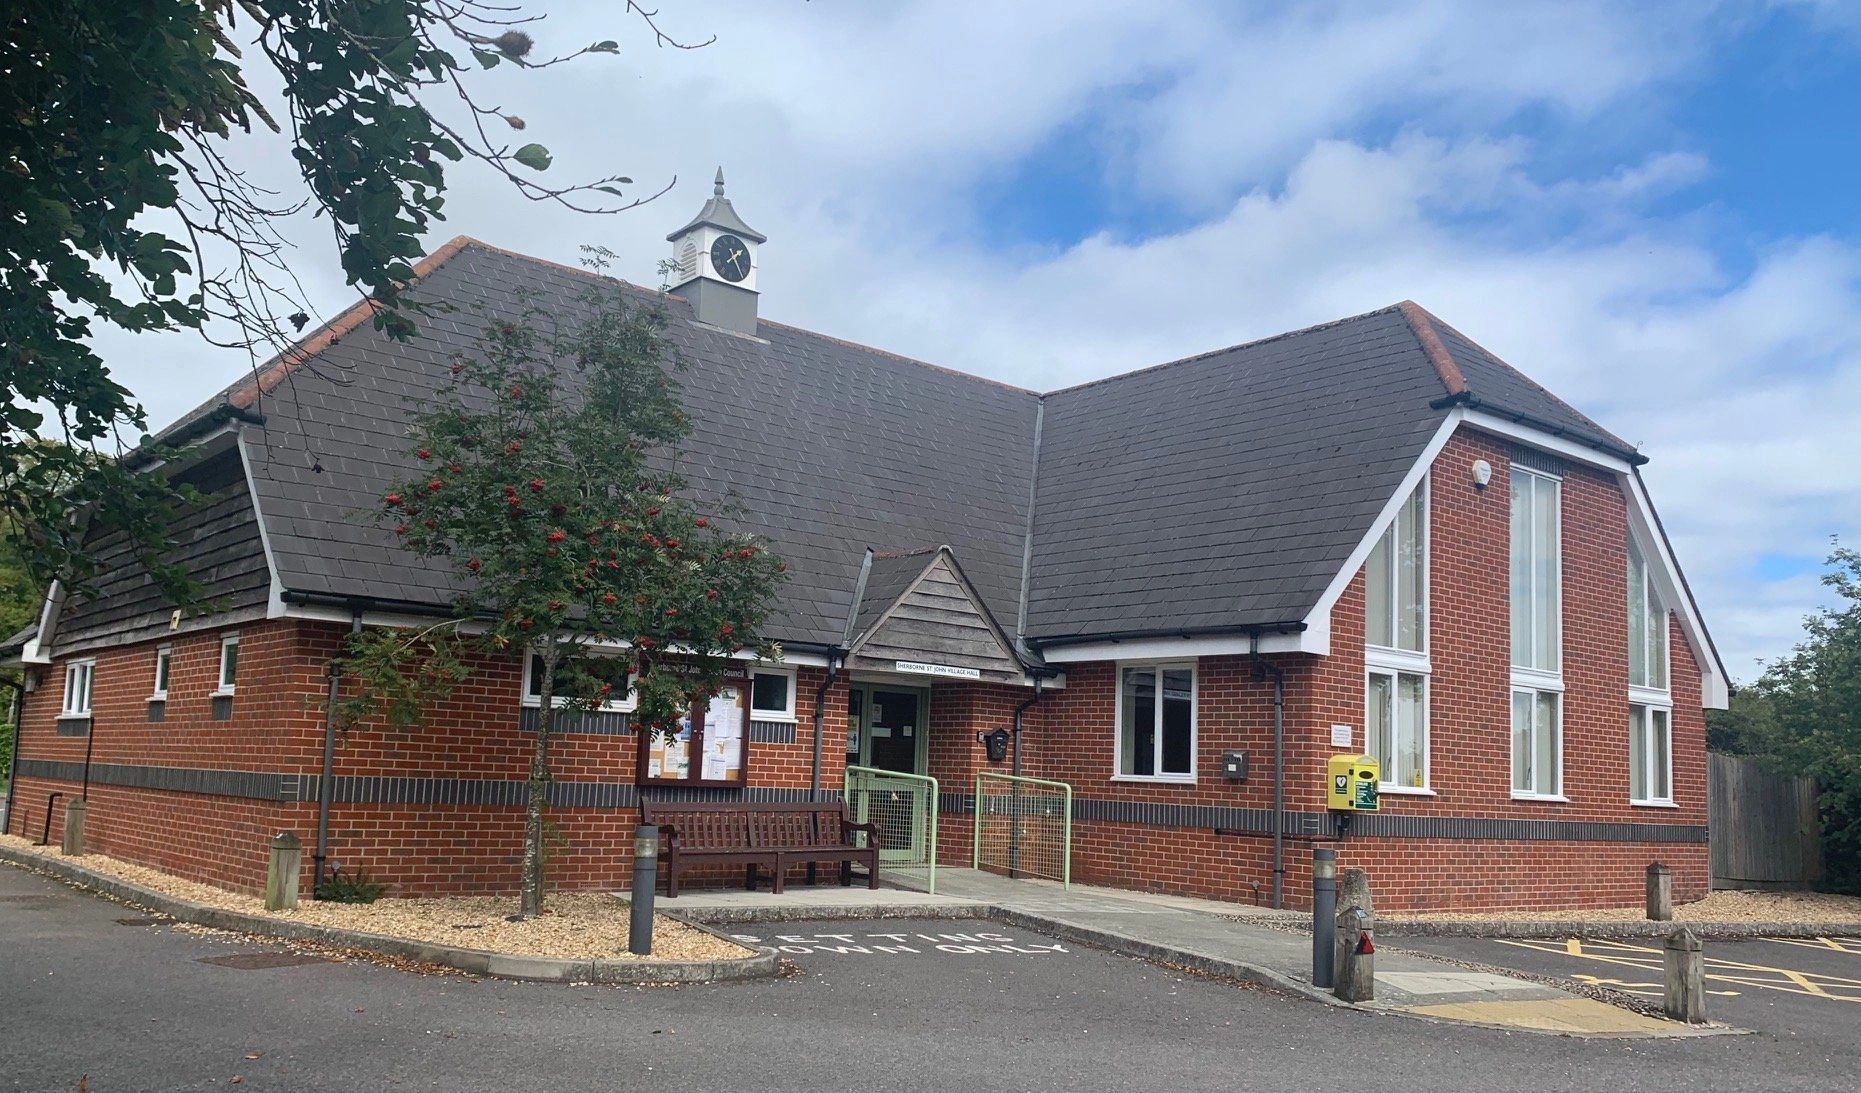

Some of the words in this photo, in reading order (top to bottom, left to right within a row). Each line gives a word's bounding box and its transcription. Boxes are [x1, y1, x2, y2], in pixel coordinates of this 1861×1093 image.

[689, 665, 701, 674] Joh
[723, 668, 744, 677] Council
[897, 662, 925, 671] SHERBORNE
[933, 665, 947, 673] JOHN
[947, 667, 966, 675] VILLAGE
[757, 945, 922, 953] OWN
[936, 944, 1069, 953] ONLY
